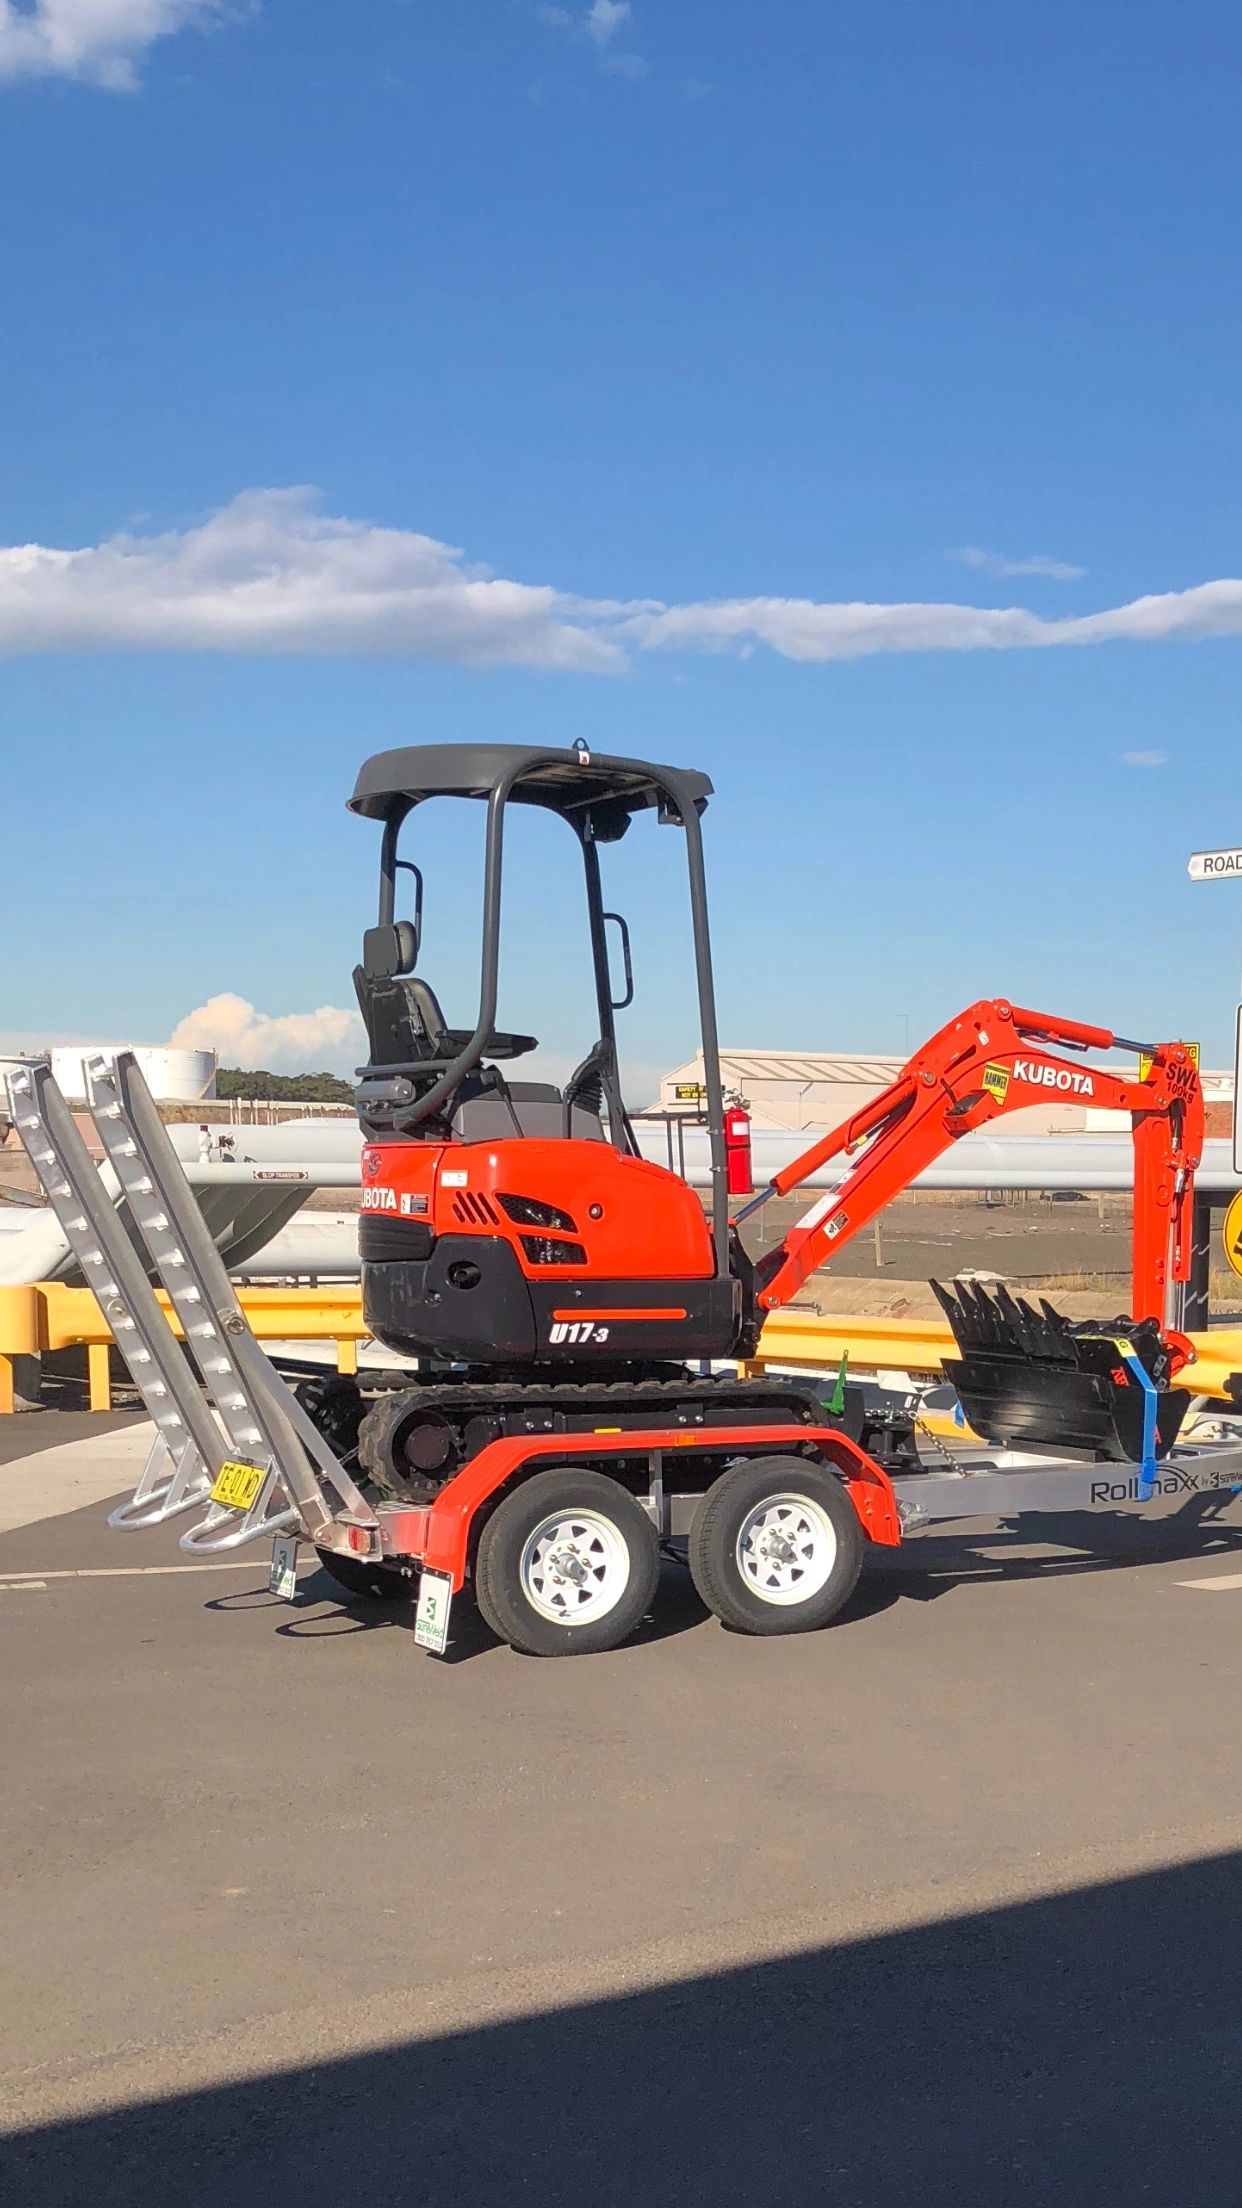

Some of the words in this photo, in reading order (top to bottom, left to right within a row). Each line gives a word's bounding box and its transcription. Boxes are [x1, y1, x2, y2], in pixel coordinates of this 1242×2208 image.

[1013, 1059, 1095, 1097] KUBOTA
[1166, 1062, 1197, 1093] SWL
[549, 1322, 609, 1344] U17-3
